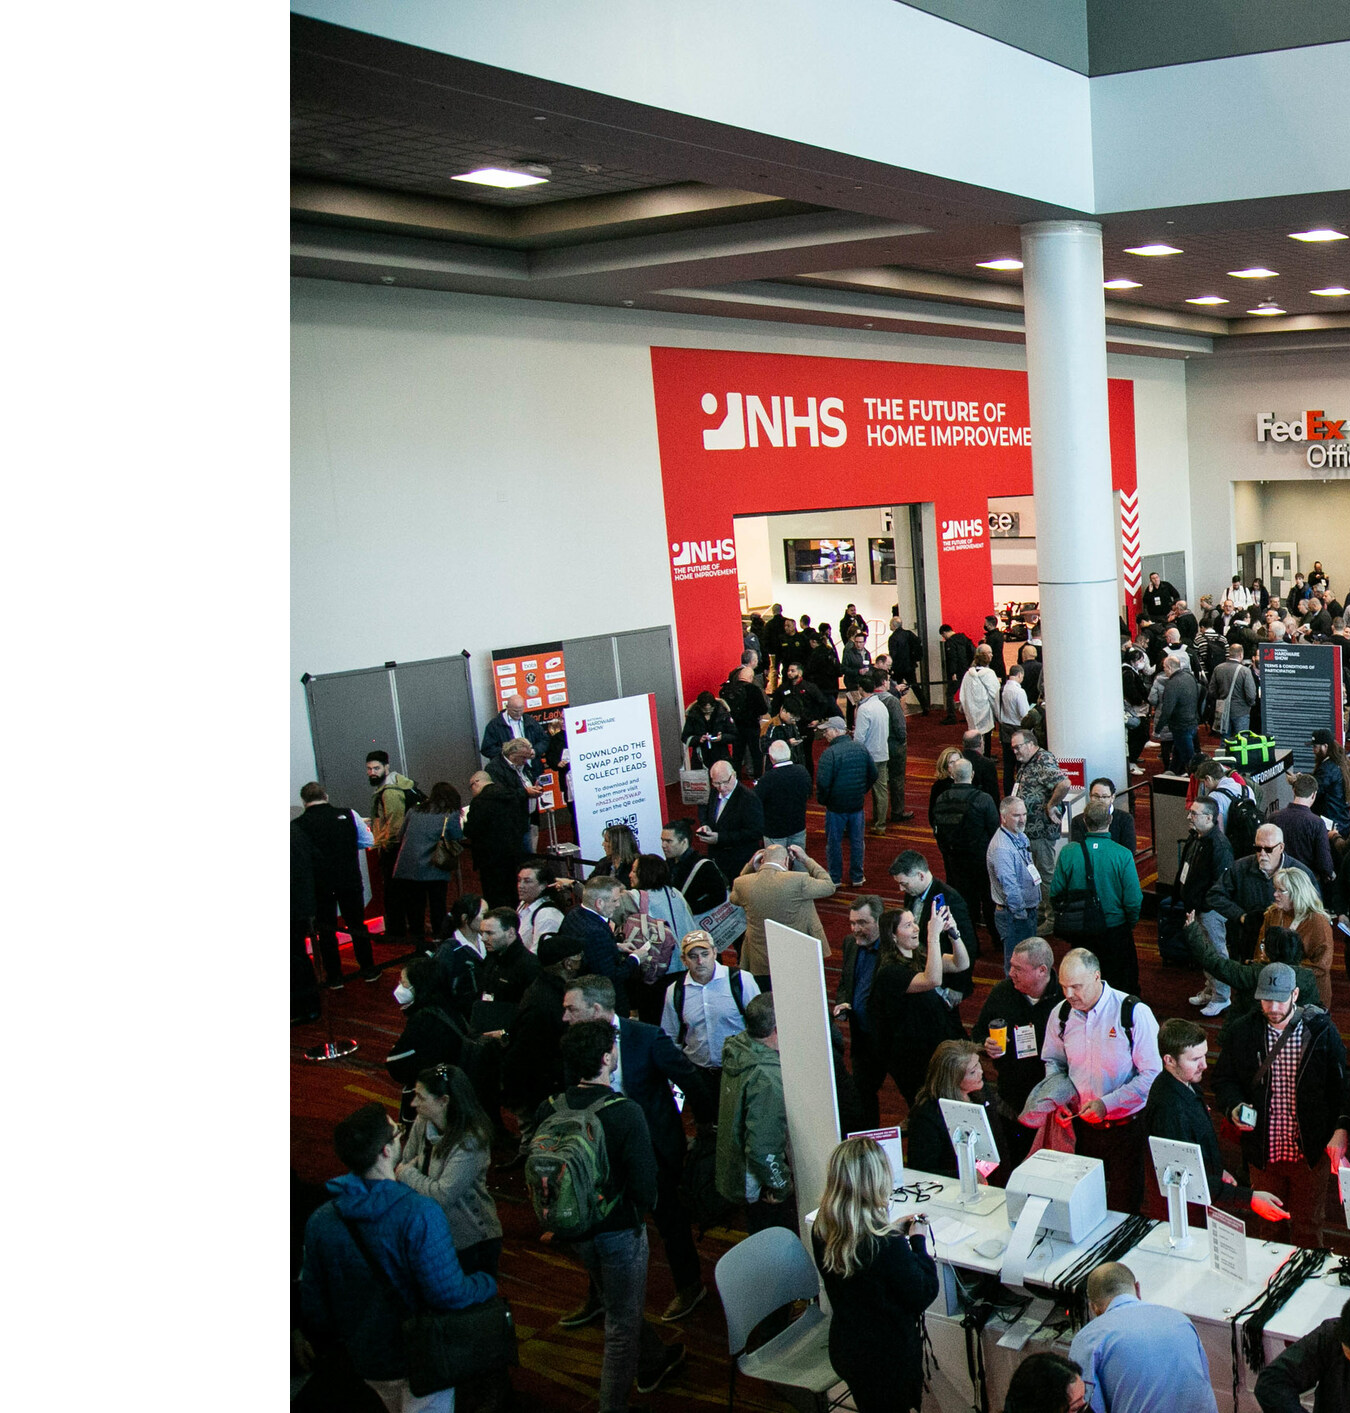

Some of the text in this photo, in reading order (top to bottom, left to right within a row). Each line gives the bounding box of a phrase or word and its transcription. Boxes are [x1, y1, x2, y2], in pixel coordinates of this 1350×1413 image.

[863, 397, 1006, 422] THE FUTURE OF
[746, 395, 848, 448] NHS
[1257, 410, 1346, 442] FedEx
[866, 424, 927, 446] HOME
[954, 518, 984, 538] NHS
[690, 538, 735, 563] NHS
[673, 562, 720, 575] THE FUTURE OF
[674, 568, 737, 581] HOME IMPROVEMENT
[587, 717, 615, 728] HARDWARE
[588, 725, 604, 733] SHOW
[579, 740, 646, 762] DOWNLOAD THE
[583, 761, 648, 782] COLLECT LEADS
[586, 752, 642, 771] SWAP APP TO
[1250, 760, 1285, 784] NFORMATION
[597, 785, 638, 799] learn more visit
[602, 780, 629, 792] download
[622, 800, 632, 808] QR
